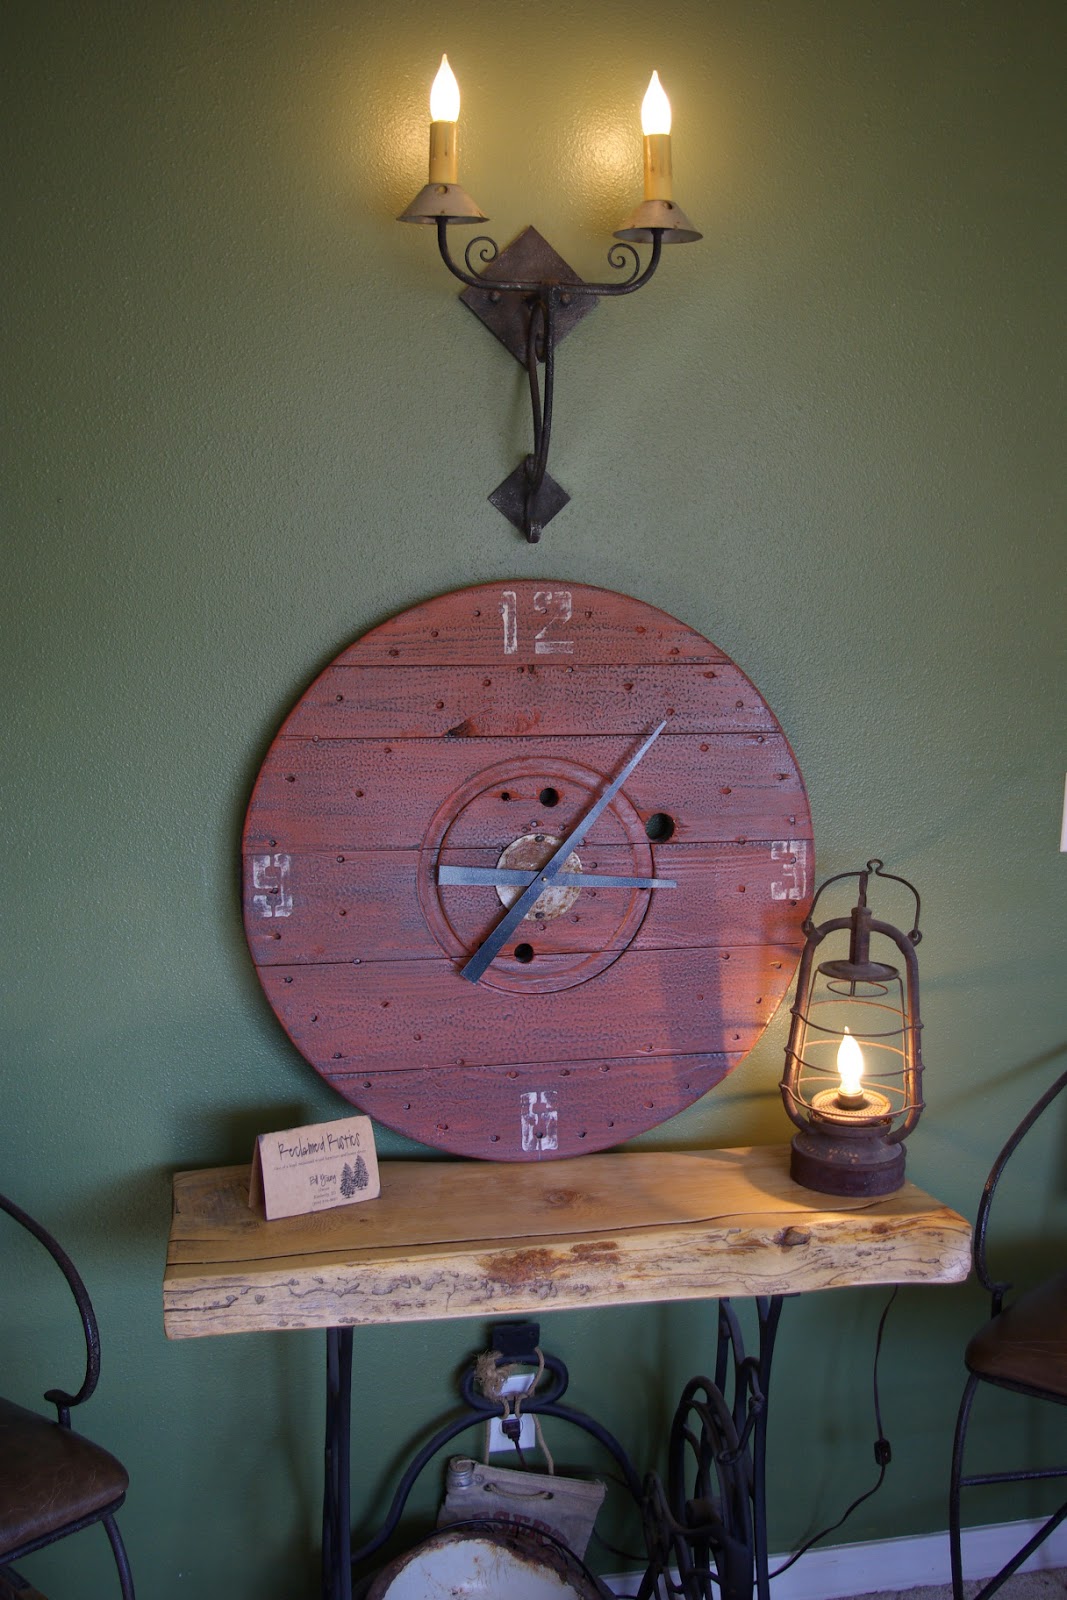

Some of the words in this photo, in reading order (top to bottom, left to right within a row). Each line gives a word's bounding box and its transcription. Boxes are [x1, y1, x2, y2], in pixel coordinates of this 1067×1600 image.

[500, 591, 574, 654] 12
[253, 853, 293, 917] 9
[771, 840, 806, 900] 3
[520, 1091, 558, 1151] 6
